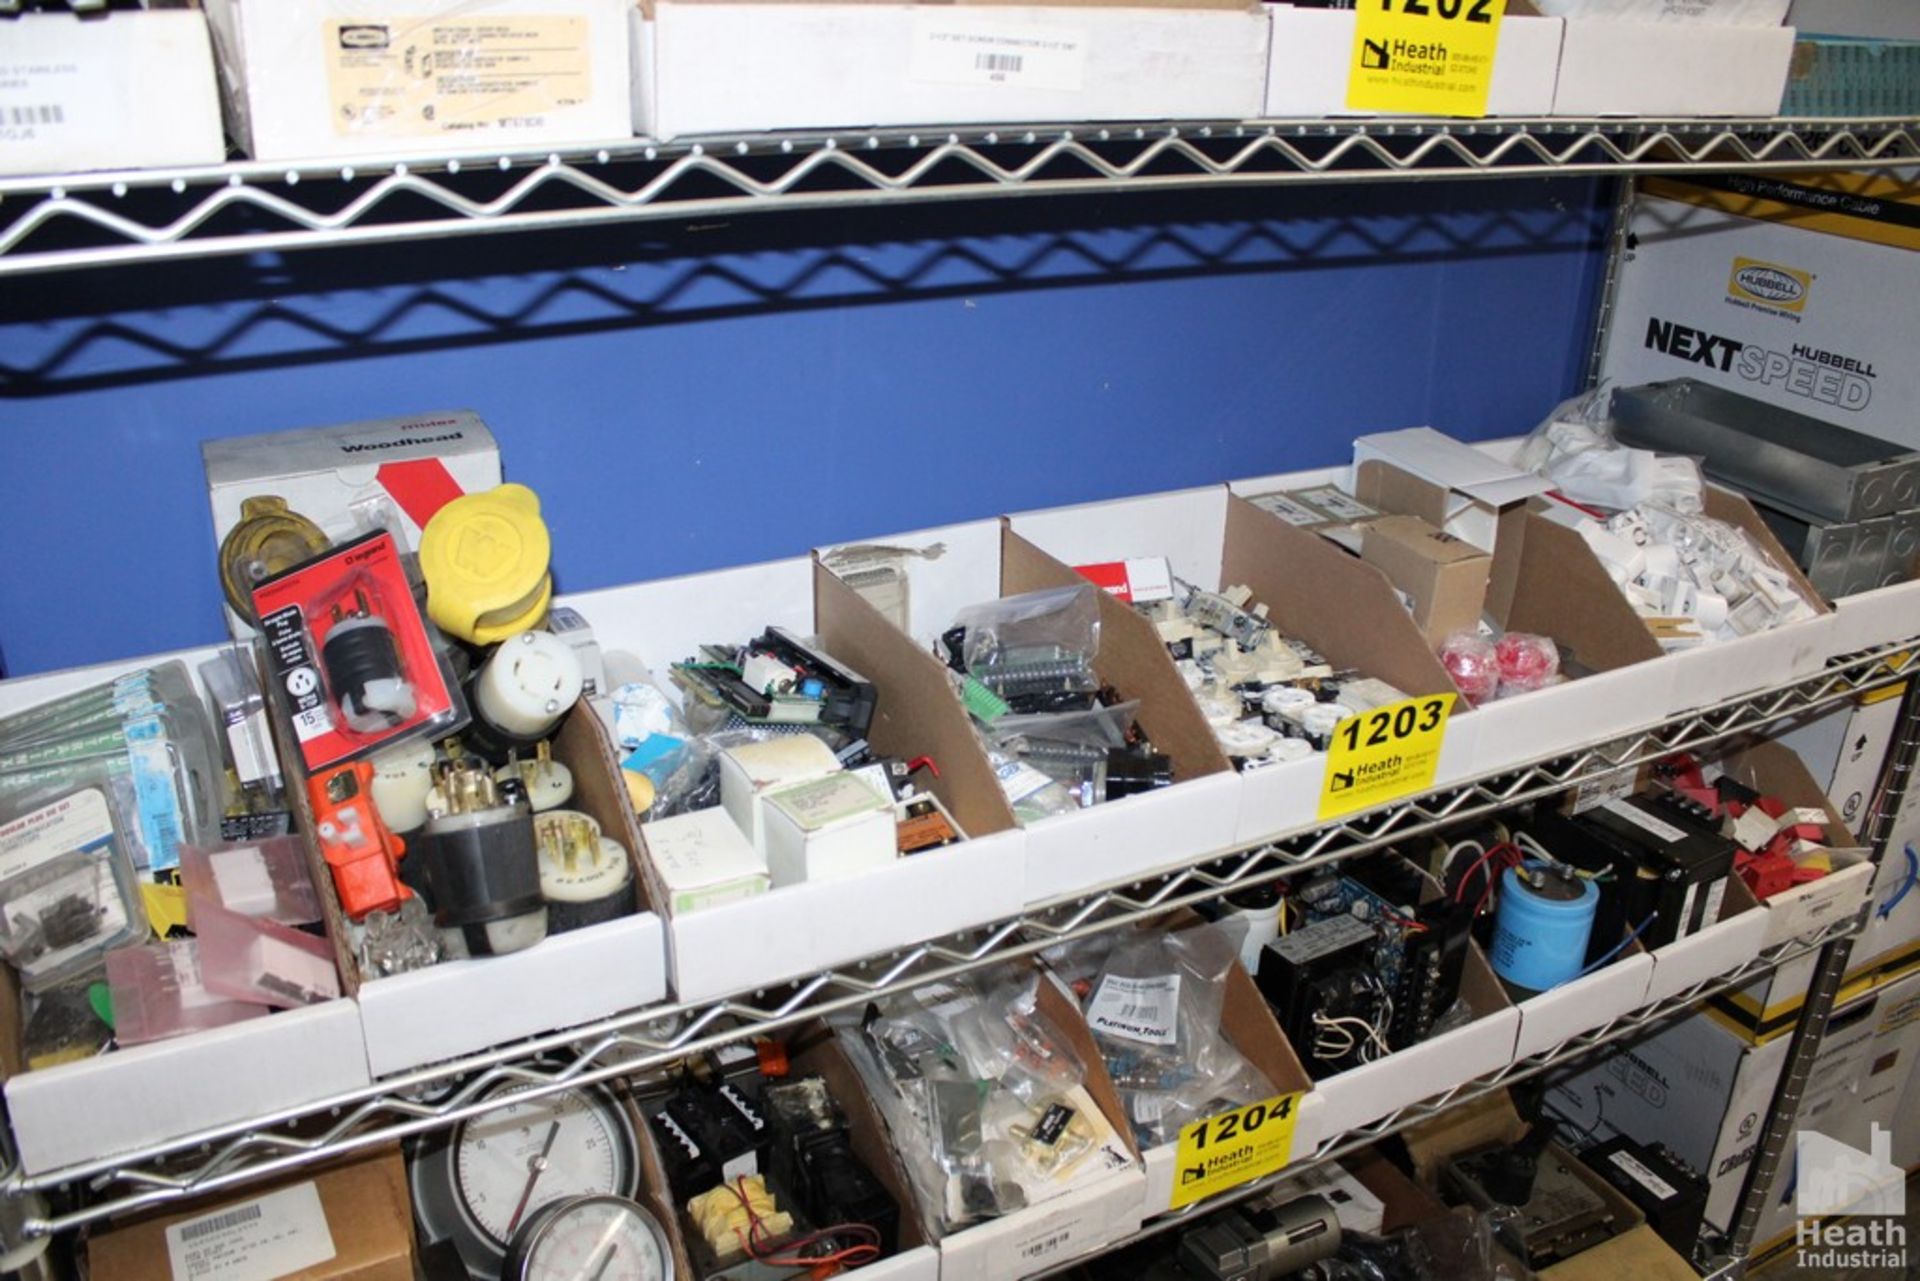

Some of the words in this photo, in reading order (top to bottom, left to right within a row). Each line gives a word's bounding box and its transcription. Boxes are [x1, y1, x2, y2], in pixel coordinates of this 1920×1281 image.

[1392, 38, 1448, 61] Heath
[1391, 59, 1447, 76] Industrial
[1728, 175, 1756, 193] High
[1757, 180, 1838, 206] Performance
[1841, 196, 1881, 215] Cable
[1623, 253, 1636, 262] UP
[1739, 273, 1798, 296] HUBBELL
[1792, 343, 1877, 379] HUBBELL
[341, 432, 463, 453] Woodhead
[354, 541, 387, 561] legrand
[300, 712, 316, 727] 15
[1343, 700, 1443, 751] 1203
[1357, 755, 1402, 776] Heath
[1096, 1016, 1141, 1033] PLATINUM
[1143, 1026, 1168, 1037] TOOLS
[1190, 1096, 1293, 1150] 1204
[586, 1137, 598, 1150] 25
[1207, 1146, 1254, 1168] Heath
